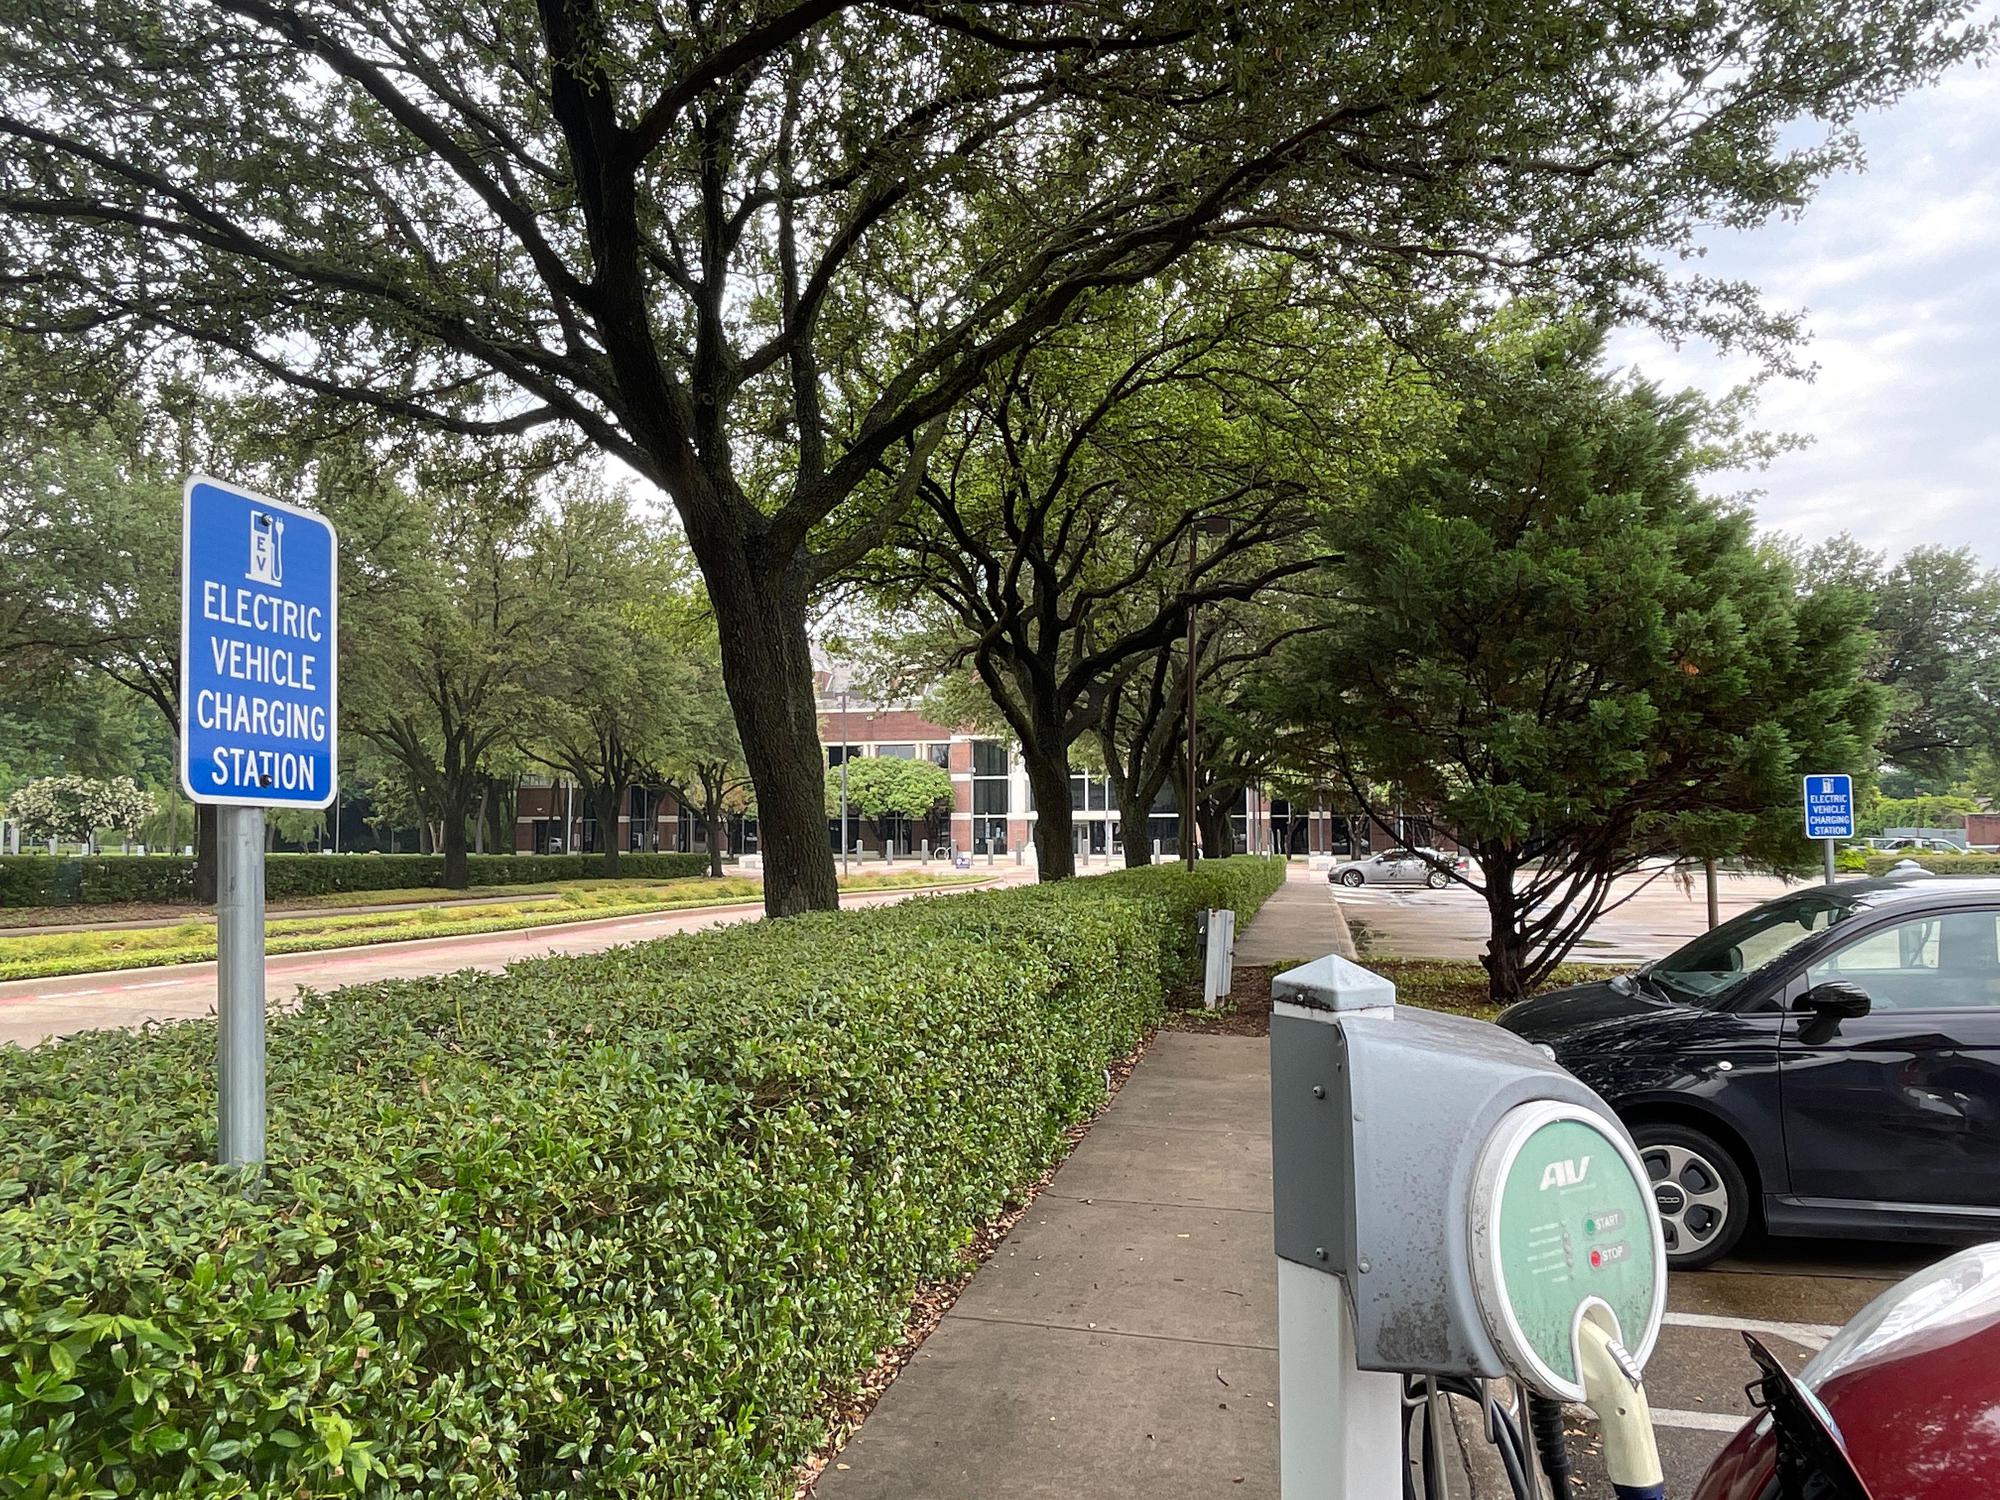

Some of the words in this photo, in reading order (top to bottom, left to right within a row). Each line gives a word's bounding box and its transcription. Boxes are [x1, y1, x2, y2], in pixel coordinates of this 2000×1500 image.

[203, 580, 322, 642] ELECTRIC
[210, 636, 316, 691] VEHICLE
[197, 689, 326, 742] CHARGING
[211, 746, 315, 791] STATION
[1810, 794, 1848, 804] ELECTRIC
[1812, 805, 1846, 814] VEHICLE
[1810, 815, 1850, 825] CHARGING
[1814, 826, 1847, 835] STATION
[1539, 1155, 1590, 1191] AV
[1595, 1213, 1619, 1230] START
[1602, 1245, 1623, 1261] STOP
